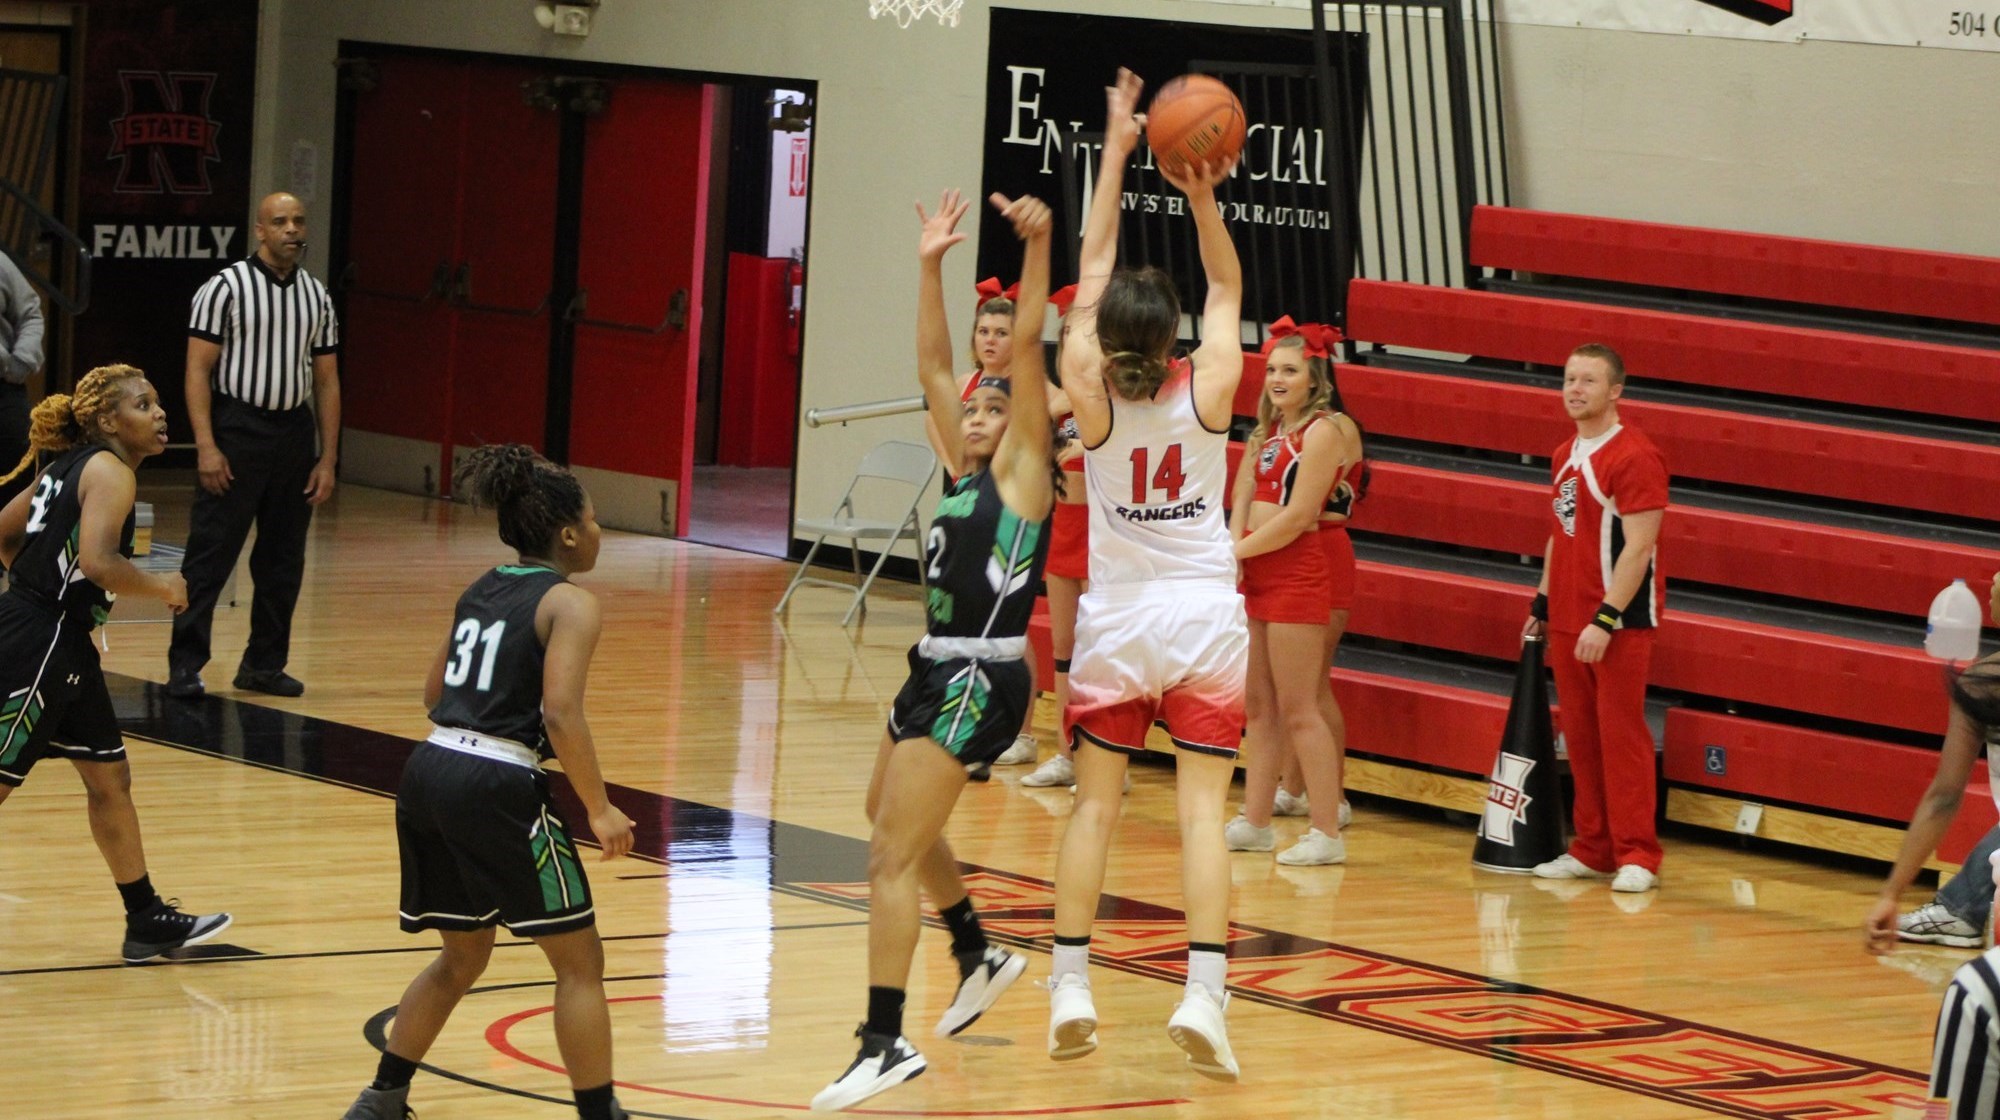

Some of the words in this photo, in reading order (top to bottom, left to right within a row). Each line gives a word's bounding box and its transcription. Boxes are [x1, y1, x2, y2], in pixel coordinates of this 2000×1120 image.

[1948, 11, 1985, 38] 504
[129, 116, 201, 142] STATE
[93, 224, 237, 259] FAMILY
[1129, 443, 1187, 504] 14
[1115, 496, 1206, 522] RANGERS
[444, 617, 507, 692] 31
